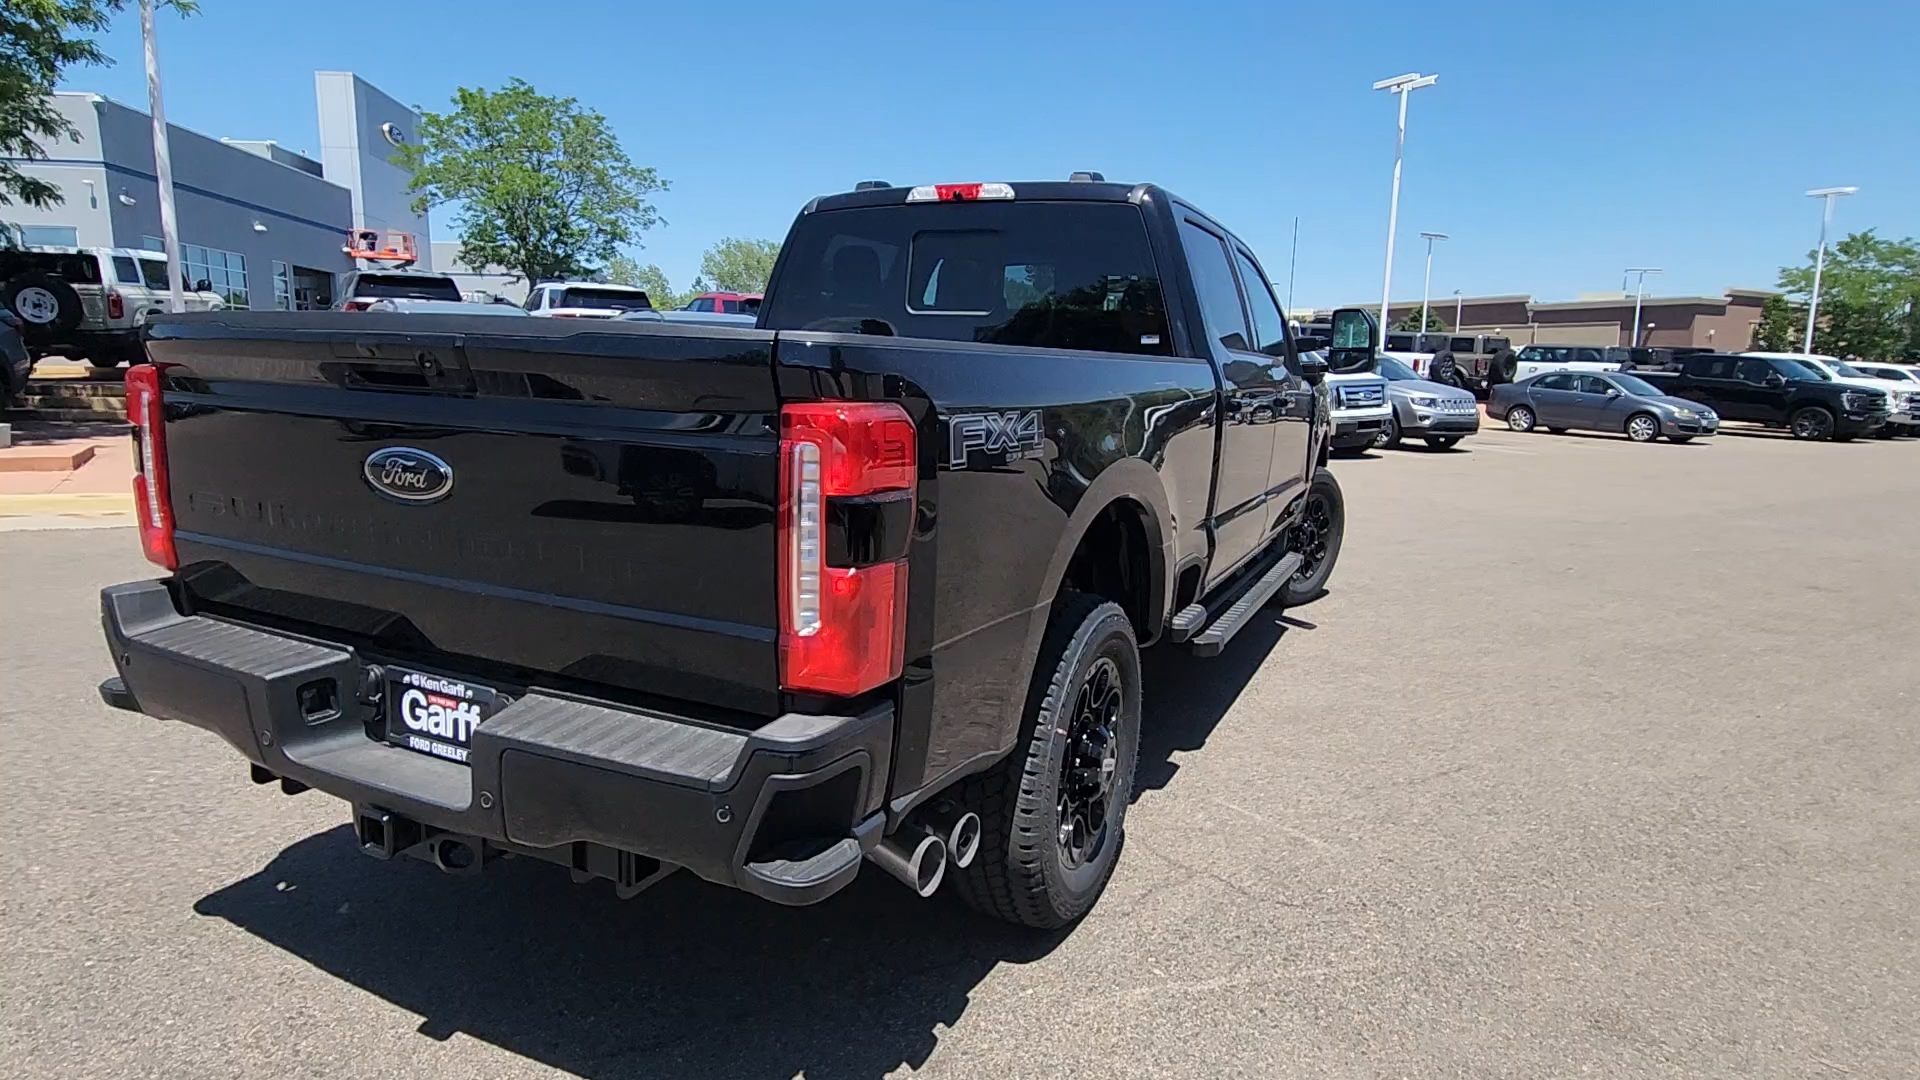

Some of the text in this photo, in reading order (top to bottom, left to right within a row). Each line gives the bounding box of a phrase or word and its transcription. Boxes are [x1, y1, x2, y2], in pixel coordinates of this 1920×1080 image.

[949, 409, 1044, 470] FX4
[381, 457, 428, 489] Ford
[402, 689, 481, 742] Garff
[409, 736, 467, 762] FORD GREELEY
